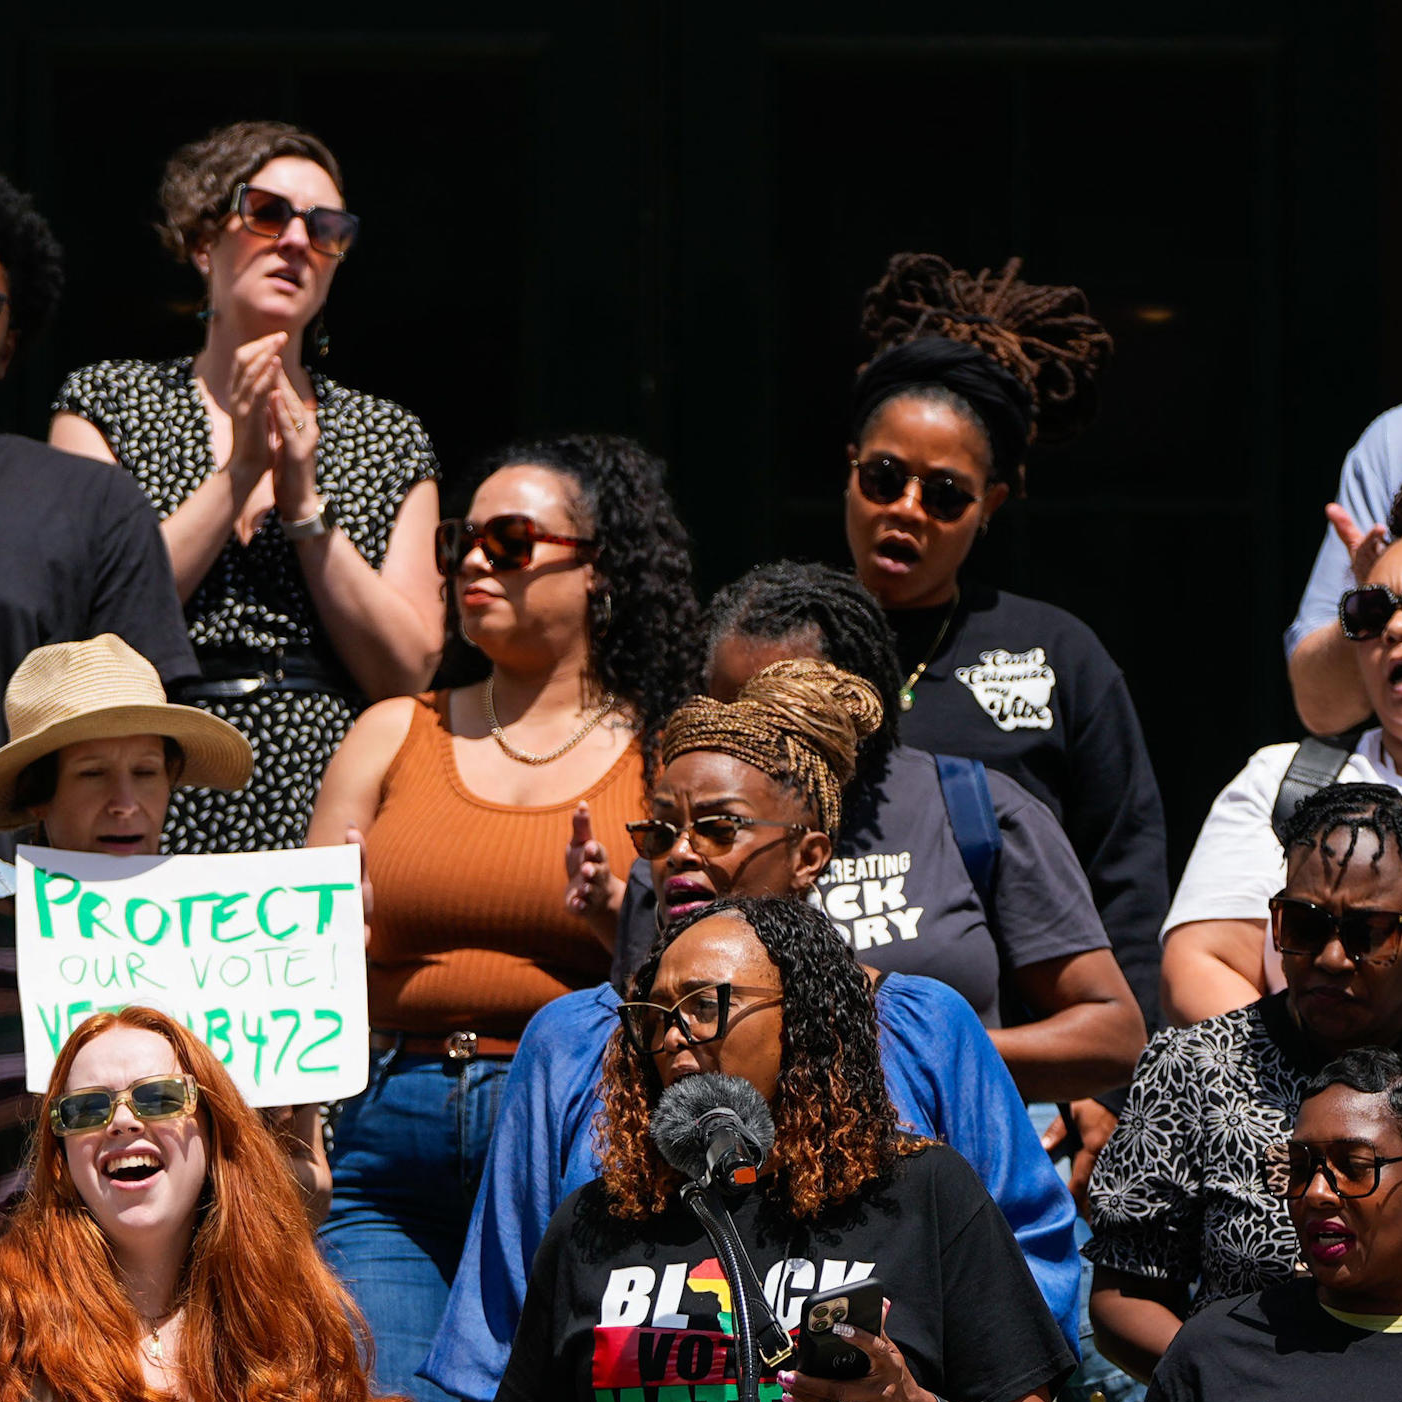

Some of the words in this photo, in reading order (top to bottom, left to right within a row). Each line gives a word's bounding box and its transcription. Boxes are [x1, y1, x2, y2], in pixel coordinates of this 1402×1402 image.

[34, 867, 355, 948] PROTECT
[59, 952, 168, 990] OUR
[190, 943, 338, 990] VOTE!
